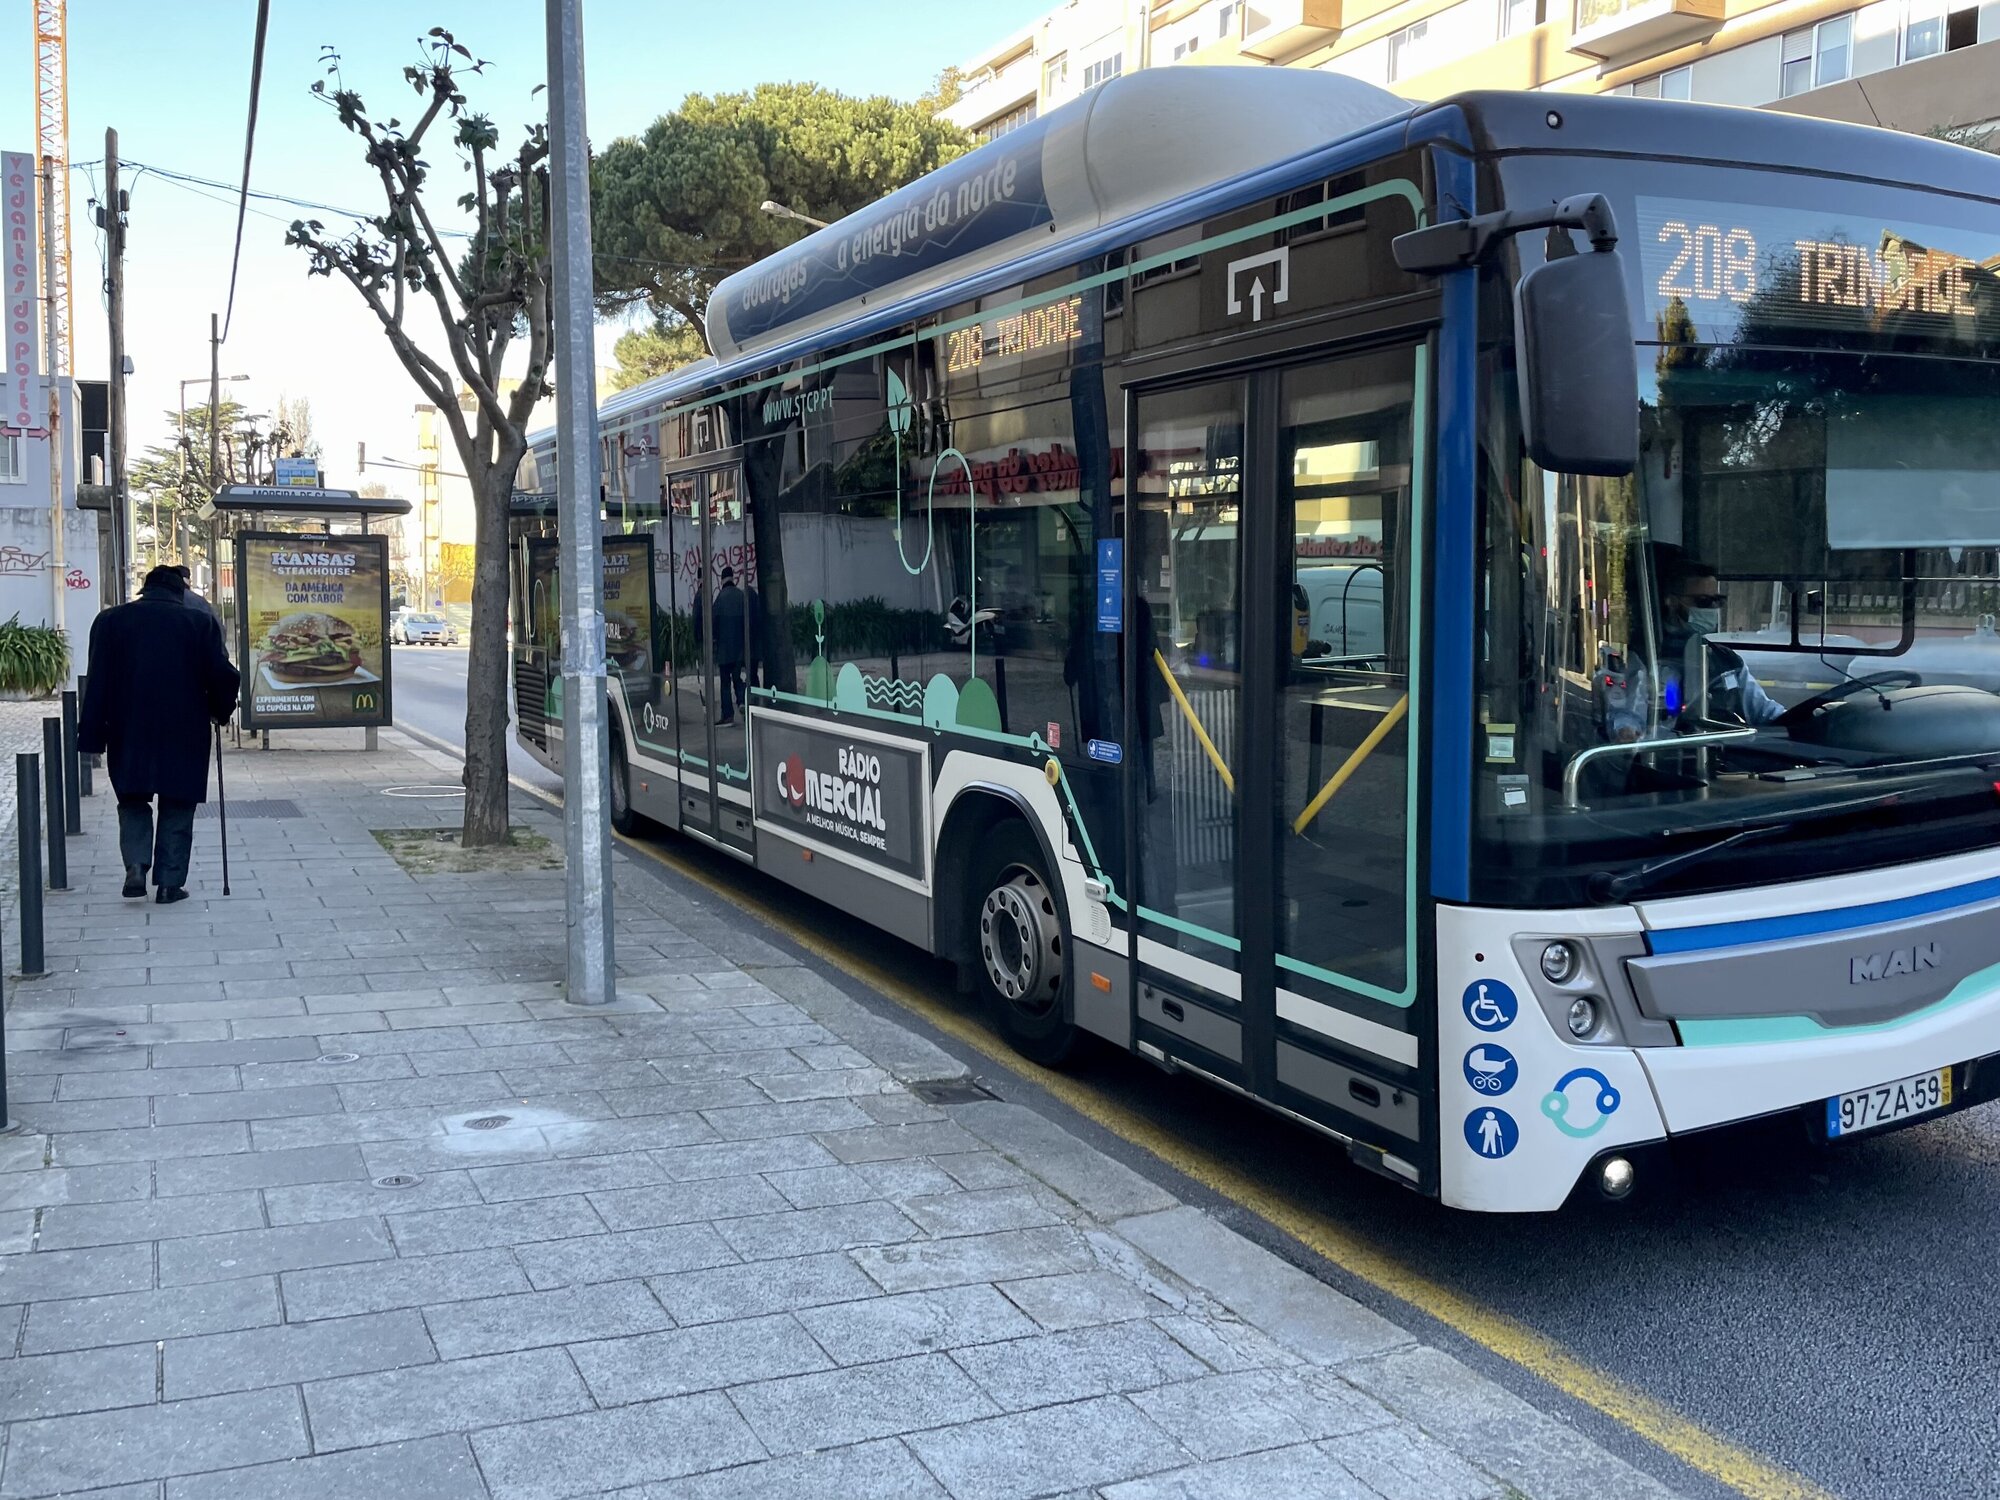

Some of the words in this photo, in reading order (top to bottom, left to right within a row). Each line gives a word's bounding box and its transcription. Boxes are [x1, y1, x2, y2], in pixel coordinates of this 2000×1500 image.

[837, 240, 847, 270] a
[851, 207, 920, 265] energia
[924, 184, 950, 232] do
[956, 158, 1017, 219] norte
[1657, 221, 1756, 302] 208
[1795, 240, 1977, 316] TRINDADE
[13, 300, 29, 335] do
[948, 324, 983, 373] 208
[996, 297, 1083, 357] TRINDADE
[15, 341, 32, 426] porto
[271, 552, 356, 567] KANSAS
[277, 566, 351, 576] STEAKHOUSE
[285, 582, 299, 593] DA
[287, 593, 309, 604] COM
[311, 593, 344, 604] SABOR
[256, 695, 300, 703] EXPERIMENTA
[300, 695, 315, 703] COM
[256, 704, 266, 712] OS
[266, 703, 291, 712] CUPÕES
[292, 703, 302, 711] NA
[302, 703, 315, 711] APP
[655, 714, 669, 730] STCP
[838, 745, 881, 784] RÁDIO
[777, 752, 886, 831] COMERCIAL
[806, 812, 812, 823] A
[811, 814, 835, 832] MELHOR
[1849, 942, 1942, 984] MAN
